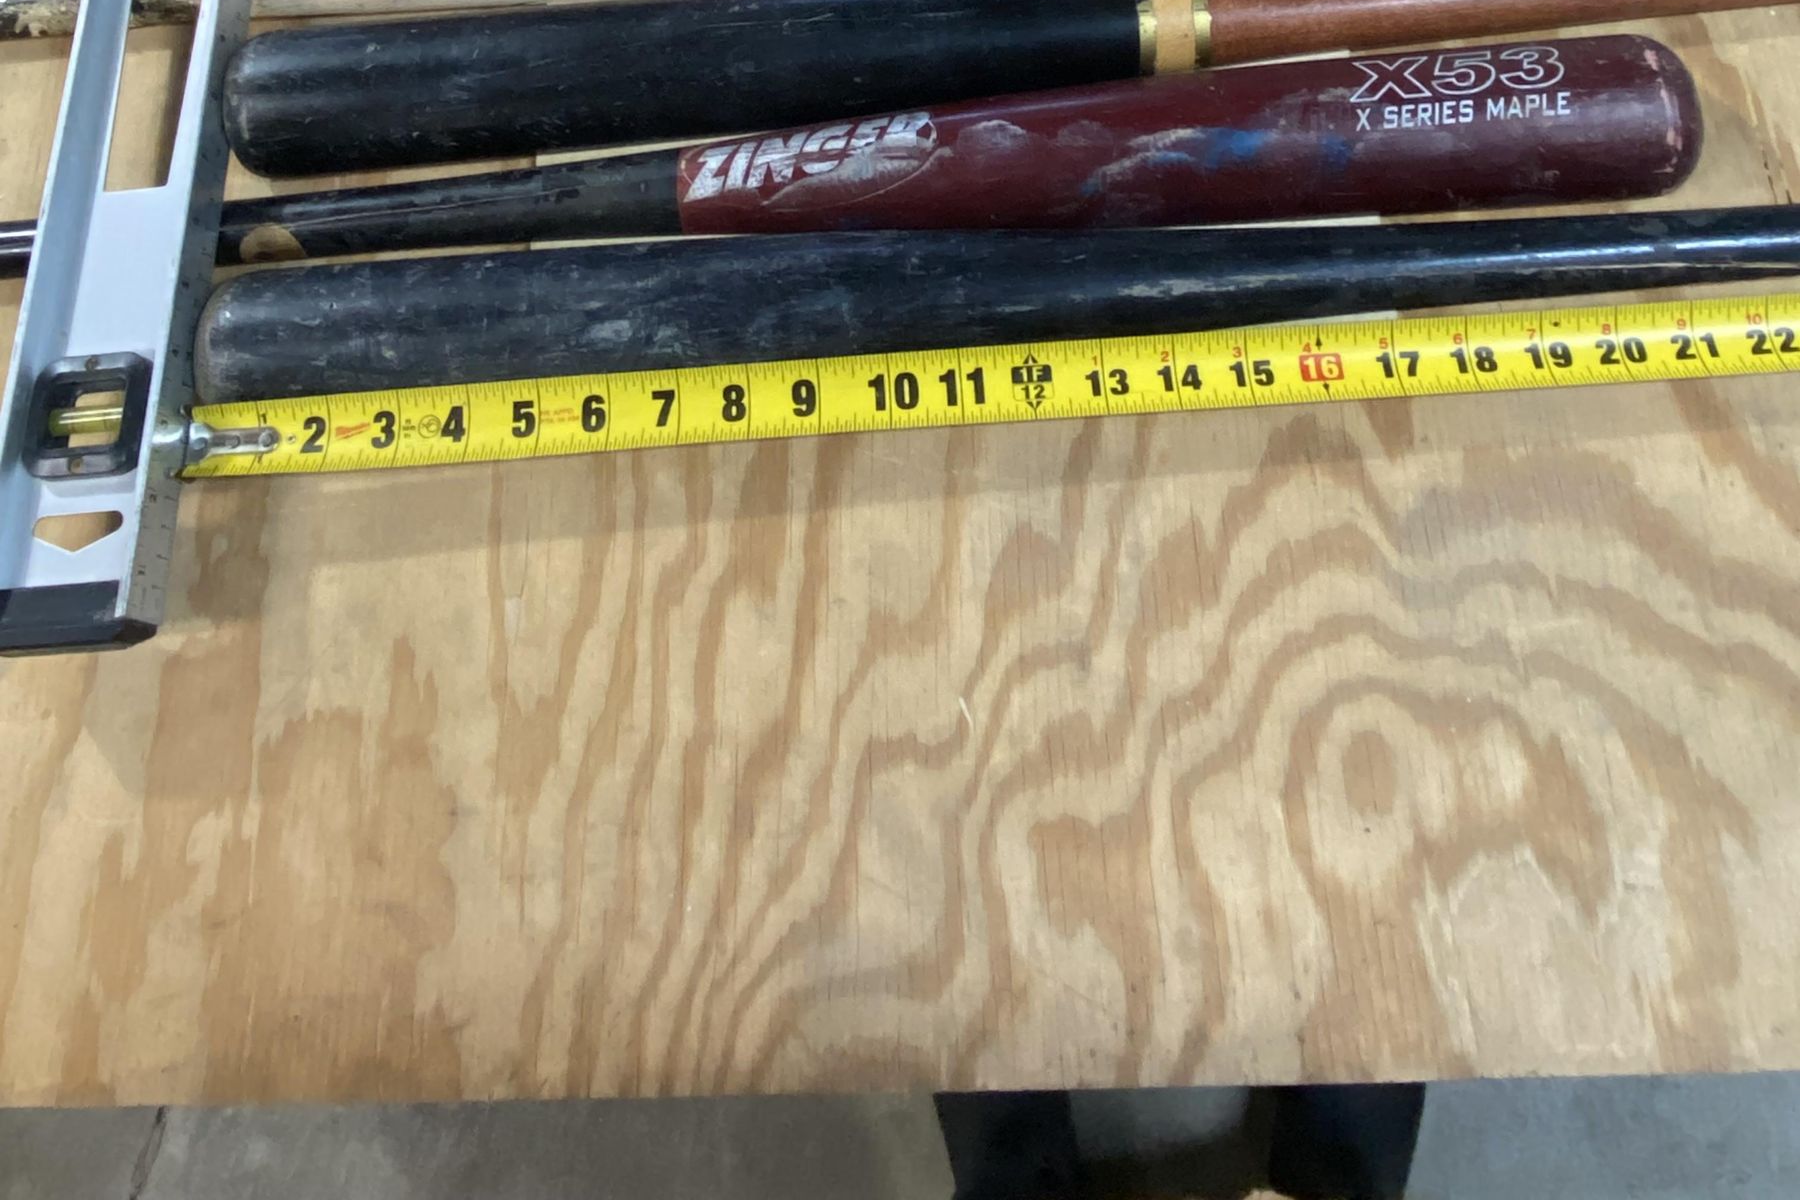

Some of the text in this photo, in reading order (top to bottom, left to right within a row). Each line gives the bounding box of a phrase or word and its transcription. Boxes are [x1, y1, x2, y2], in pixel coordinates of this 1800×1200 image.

[1350, 46, 1565, 102] X53
[1355, 91, 1571, 132] X SERIES MAPLE
[1085, 327, 1800, 397] 13 14 15 16 17 18 19 20 21 22
[1160, 350, 1170, 363] 2
[1233, 346, 1243, 359] 3
[1302, 342, 1312, 354] 4
[1379, 337, 1388, 349] 5
[1453, 333, 1463, 345] 6
[1527, 328, 1536, 339] 7
[1602, 323, 1612, 335] 8
[1677, 318, 1687, 330] 9
[1019, 367, 1044, 383] 1F
[1021, 385, 1046, 400] 12
[300, 416, 327, 454] 2
[371, 410, 396, 449] 3
[441, 405, 466, 443] 4
[512, 400, 536, 439] 5
[582, 394, 606, 433] 6
[651, 389, 676, 428] 7
[722, 384, 747, 423] 8
[791, 379, 816, 417] 9
[868, 372, 920, 411] 10
[939, 367, 986, 407] 11
